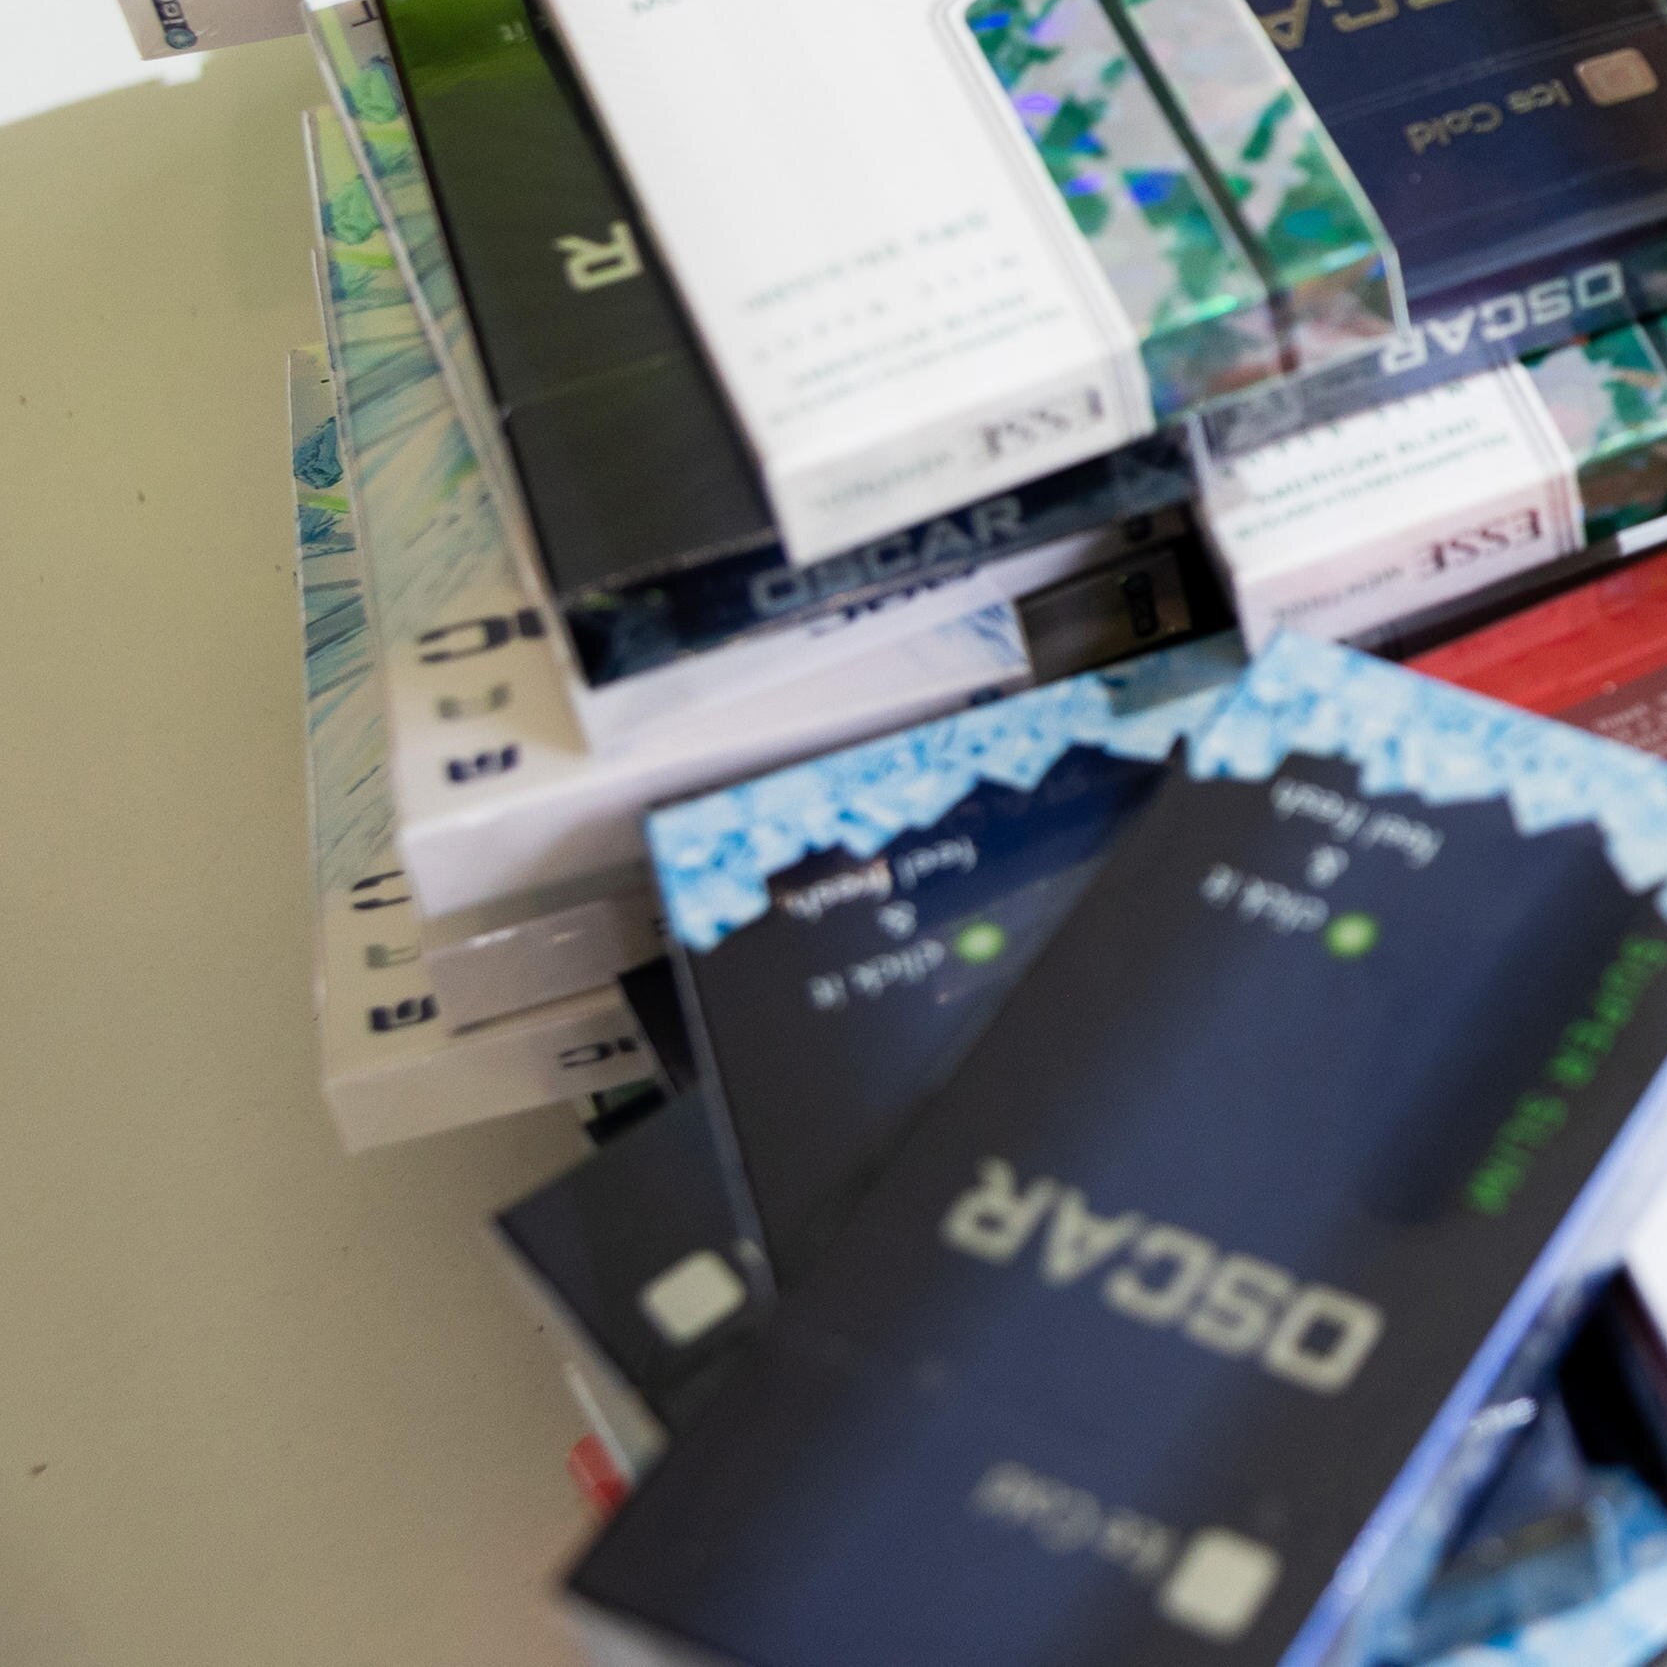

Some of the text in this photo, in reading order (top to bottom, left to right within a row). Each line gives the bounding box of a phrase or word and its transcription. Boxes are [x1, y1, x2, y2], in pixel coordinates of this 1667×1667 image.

[1405, 77, 1567, 156] Ice Cold
[1378, 259, 1626, 376] OSCAR
[1416, 506, 1546, 580] ESSE
[939, 1156, 1389, 1396] OSCAR
